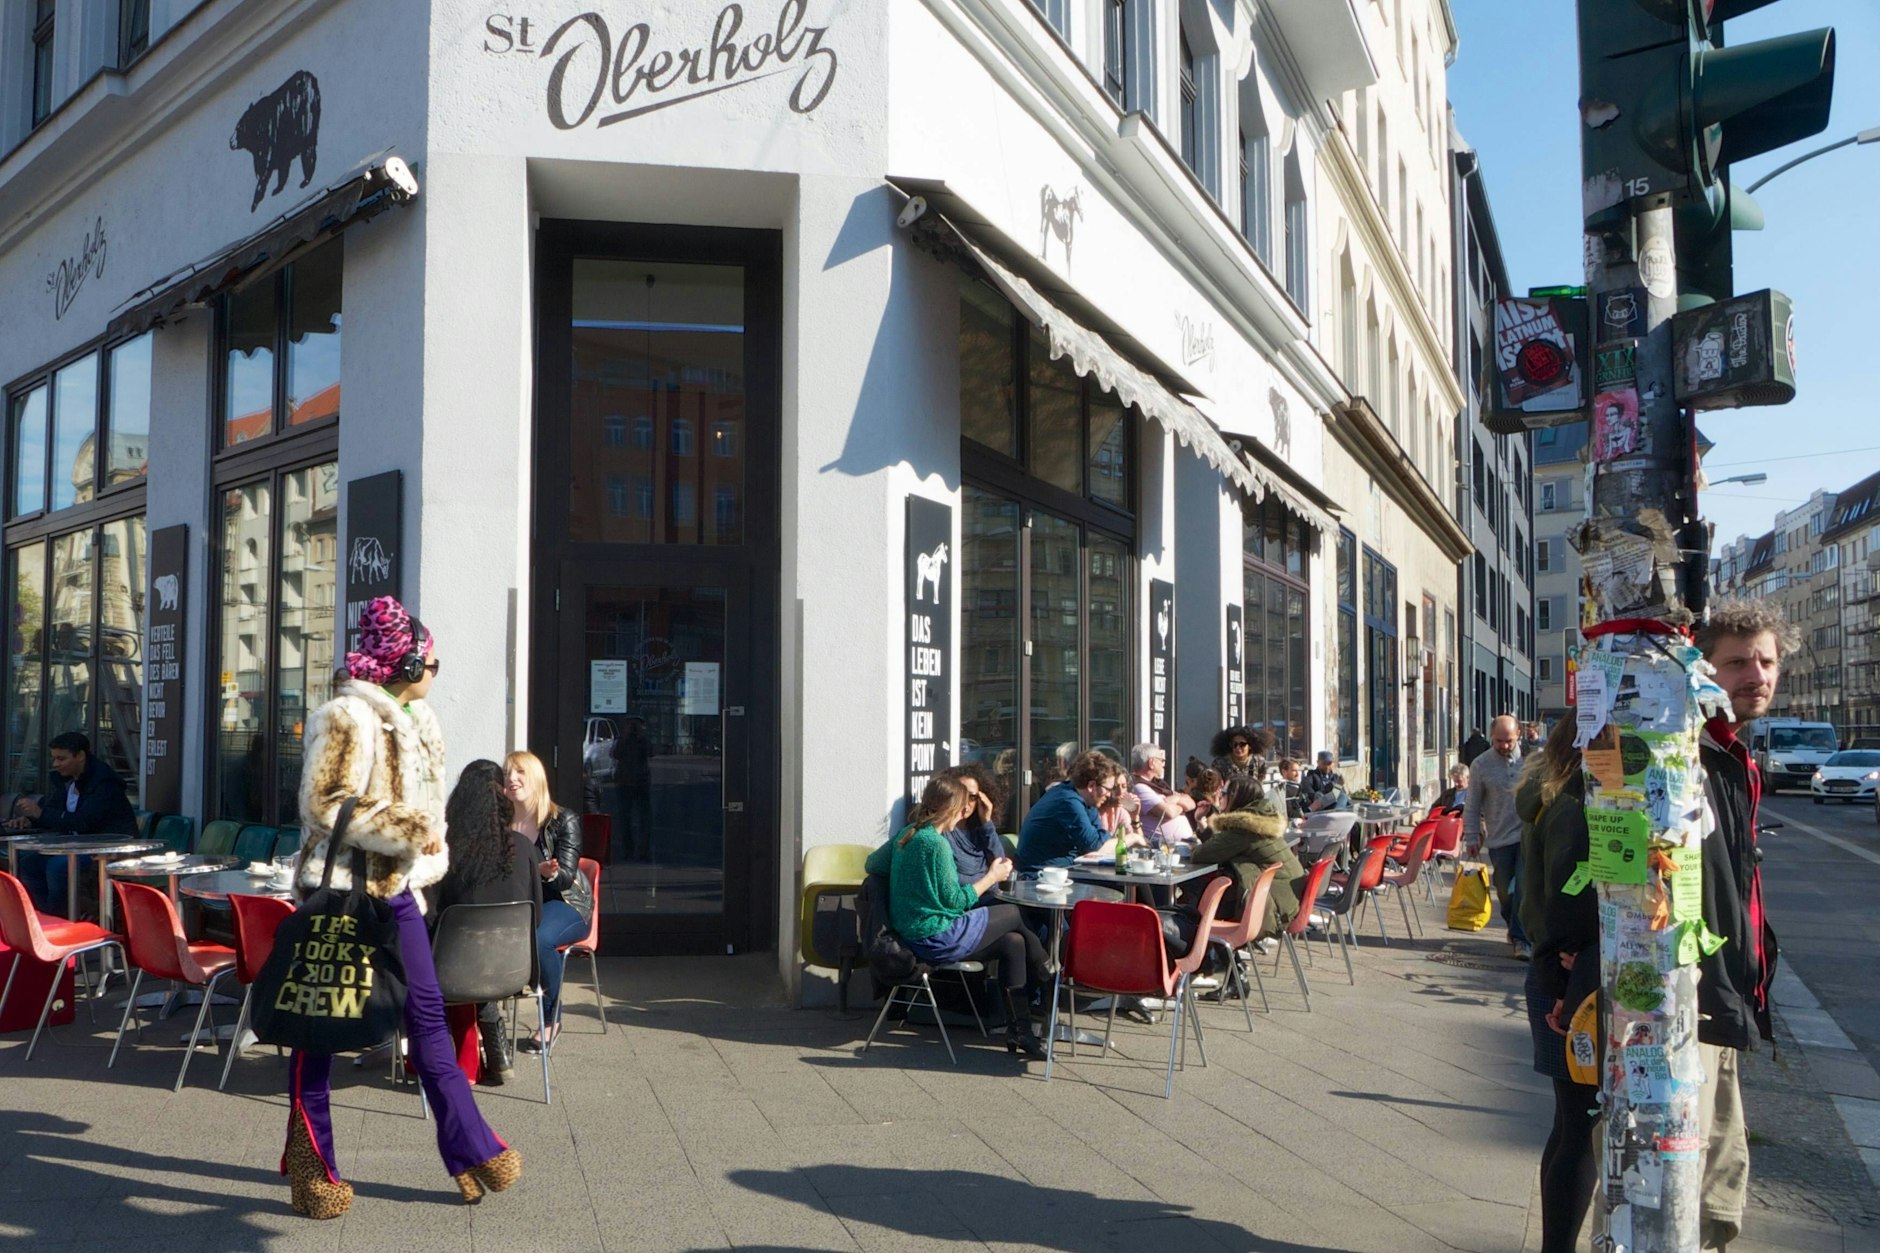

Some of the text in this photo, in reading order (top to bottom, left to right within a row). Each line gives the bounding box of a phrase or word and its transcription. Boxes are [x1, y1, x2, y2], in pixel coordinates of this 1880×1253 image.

[484, 0, 837, 130] St Oberholz
[1625, 177, 1649, 197] 15
[1498, 315, 1557, 347] LATNUM
[348, 600, 369, 630] NIC
[151, 624, 175, 643] VERTEILE
[912, 614, 931, 644] DAS
[150, 643, 175, 661] DAS FELL
[912, 646, 941, 676] LEBEN
[150, 661, 179, 681] DES BÄREN
[149, 682, 164, 699] NICHT
[912, 679, 927, 707] IST
[149, 701, 165, 718] BEVOR
[912, 711, 933, 740] KEIN
[148, 740, 167, 757] ERLEGT
[911, 743, 935, 772] PONY
[1601, 824, 1630, 834] VOICE
[1610, 815, 1624, 824] UP
[310, 914, 358, 936] THE
[274, 981, 371, 1019] CREW
[1626, 1047, 1664, 1058] ANALOG
